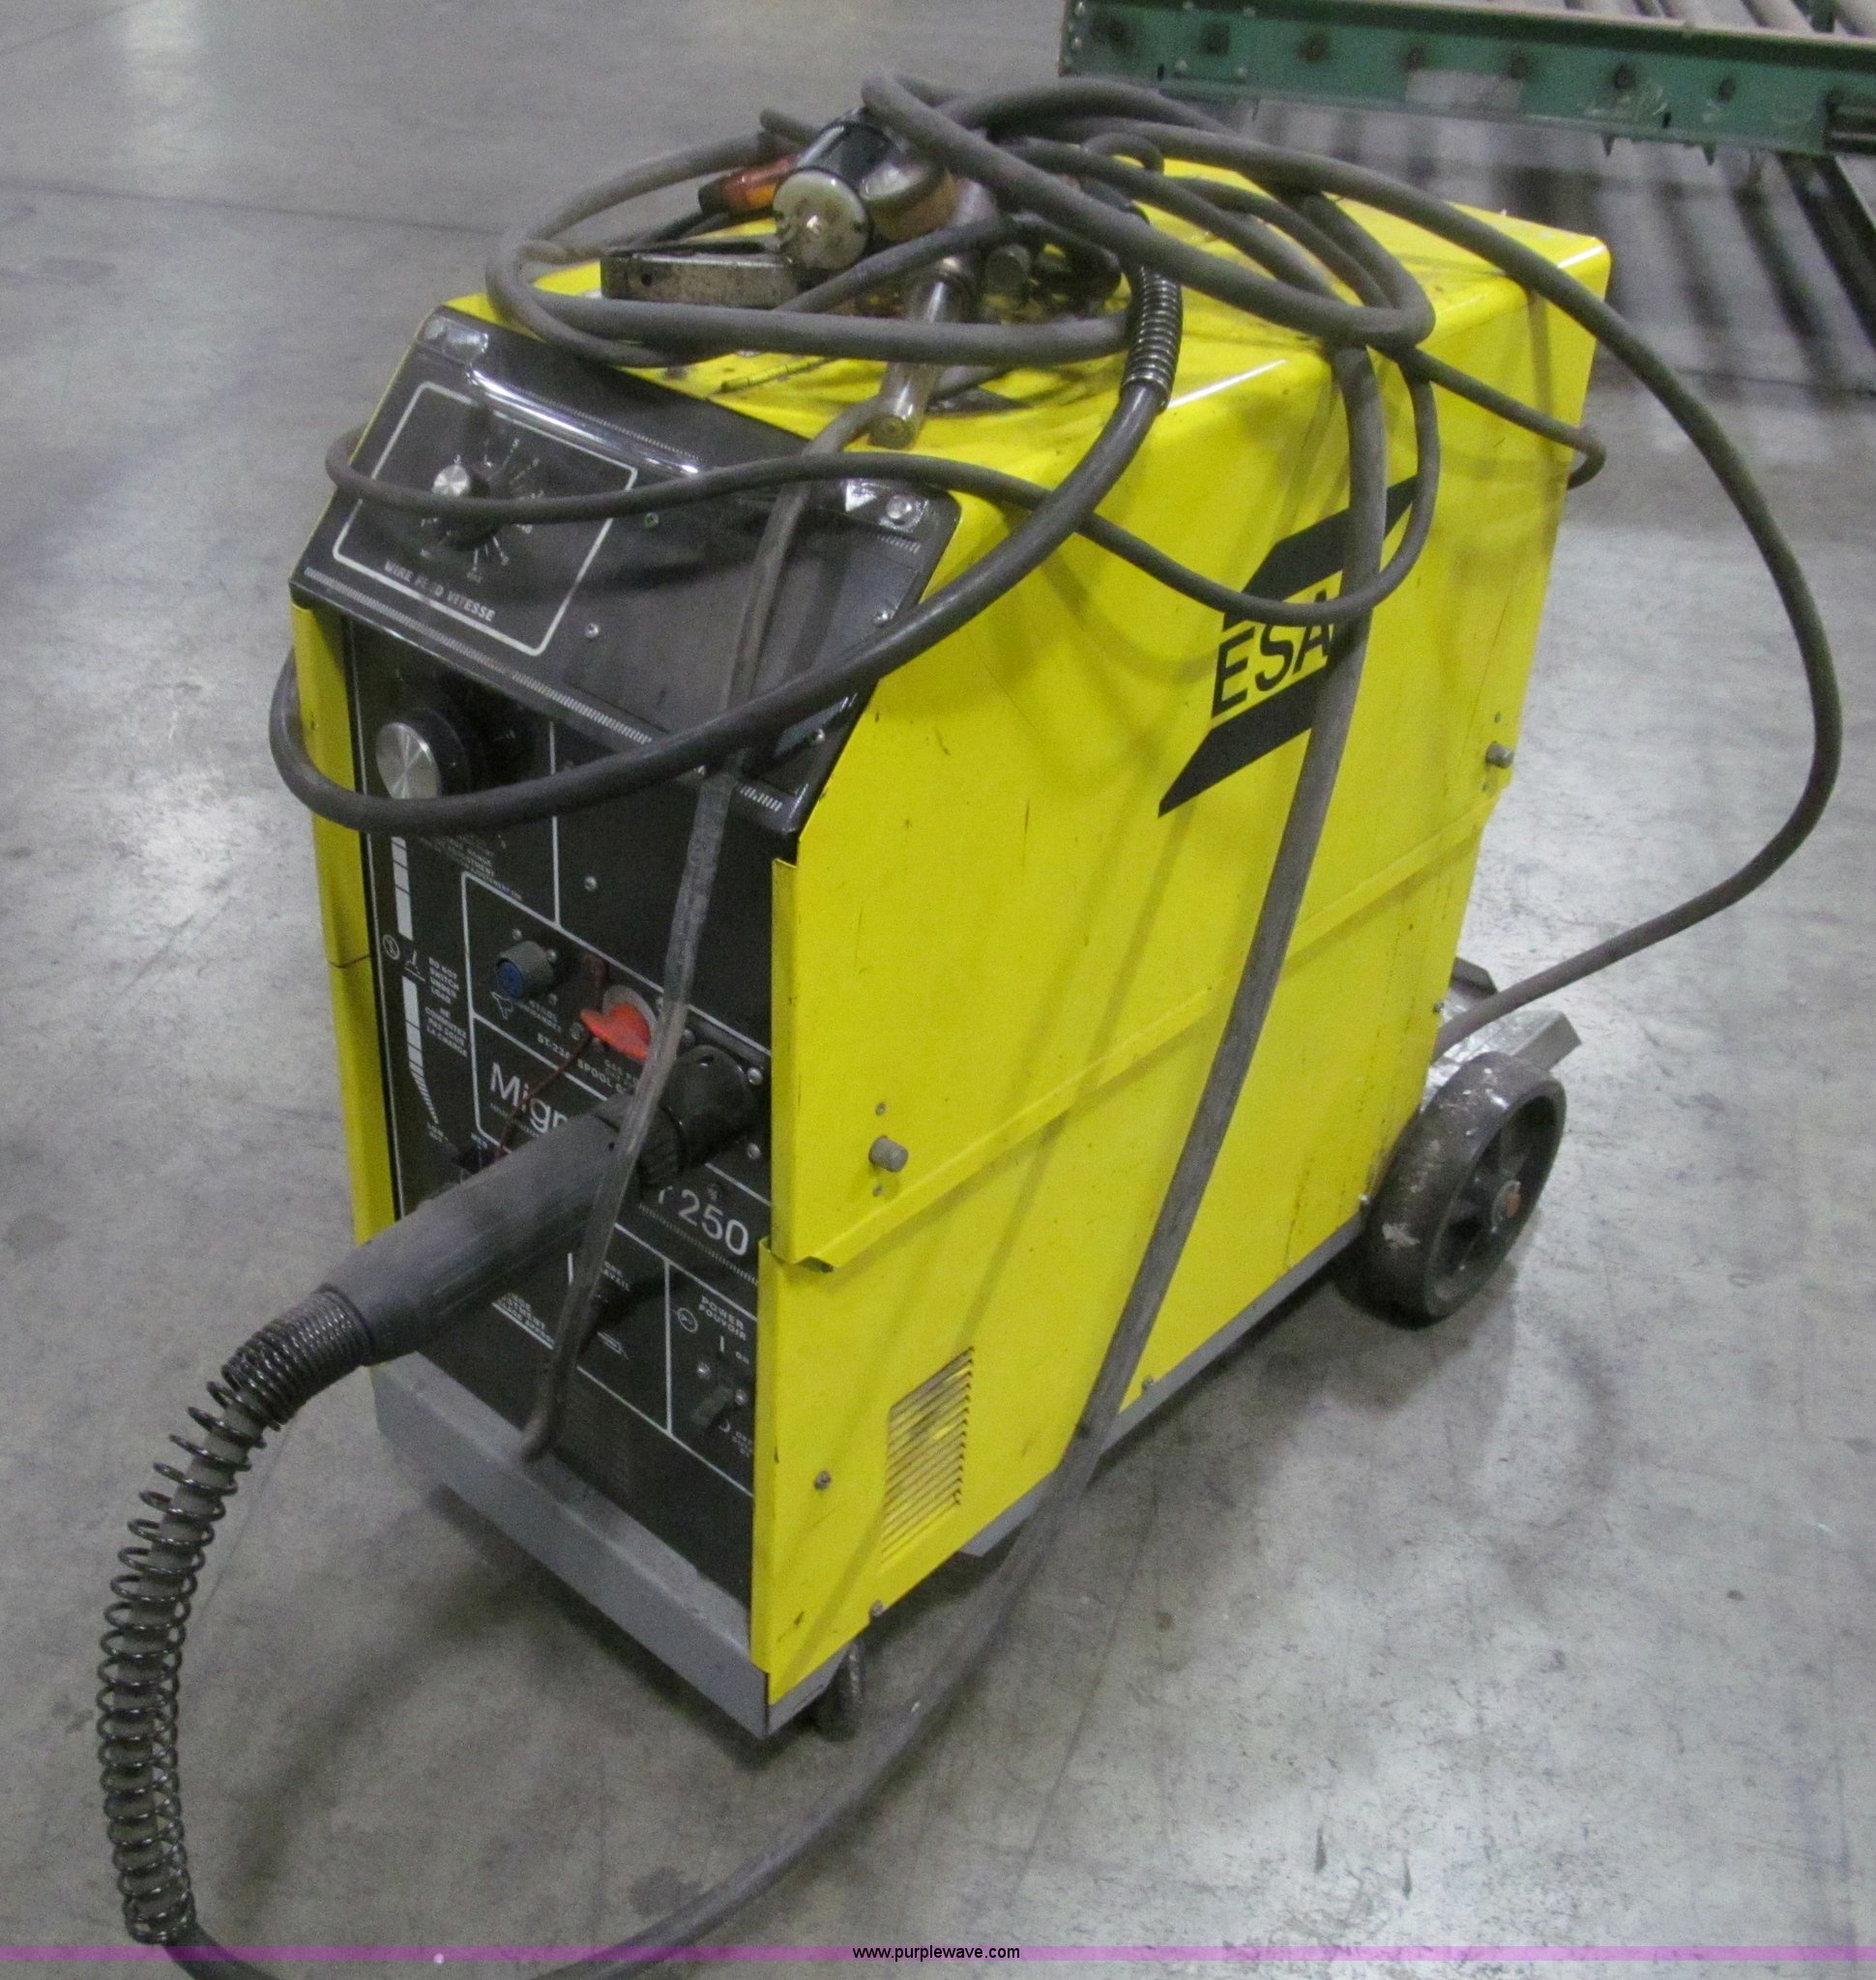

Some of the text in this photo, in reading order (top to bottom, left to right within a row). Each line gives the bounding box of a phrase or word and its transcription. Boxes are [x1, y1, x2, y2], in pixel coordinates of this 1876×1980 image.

[384, 559, 414, 584] WIRE
[447, 591, 496, 623] VITESSE
[1211, 589, 1333, 718] ESA
[577, 1059, 612, 1089] SPOOL
[678, 1188, 749, 1257] 250
[698, 1303, 747, 1342] POUVOIR
[701, 1296, 744, 1331] POWER
